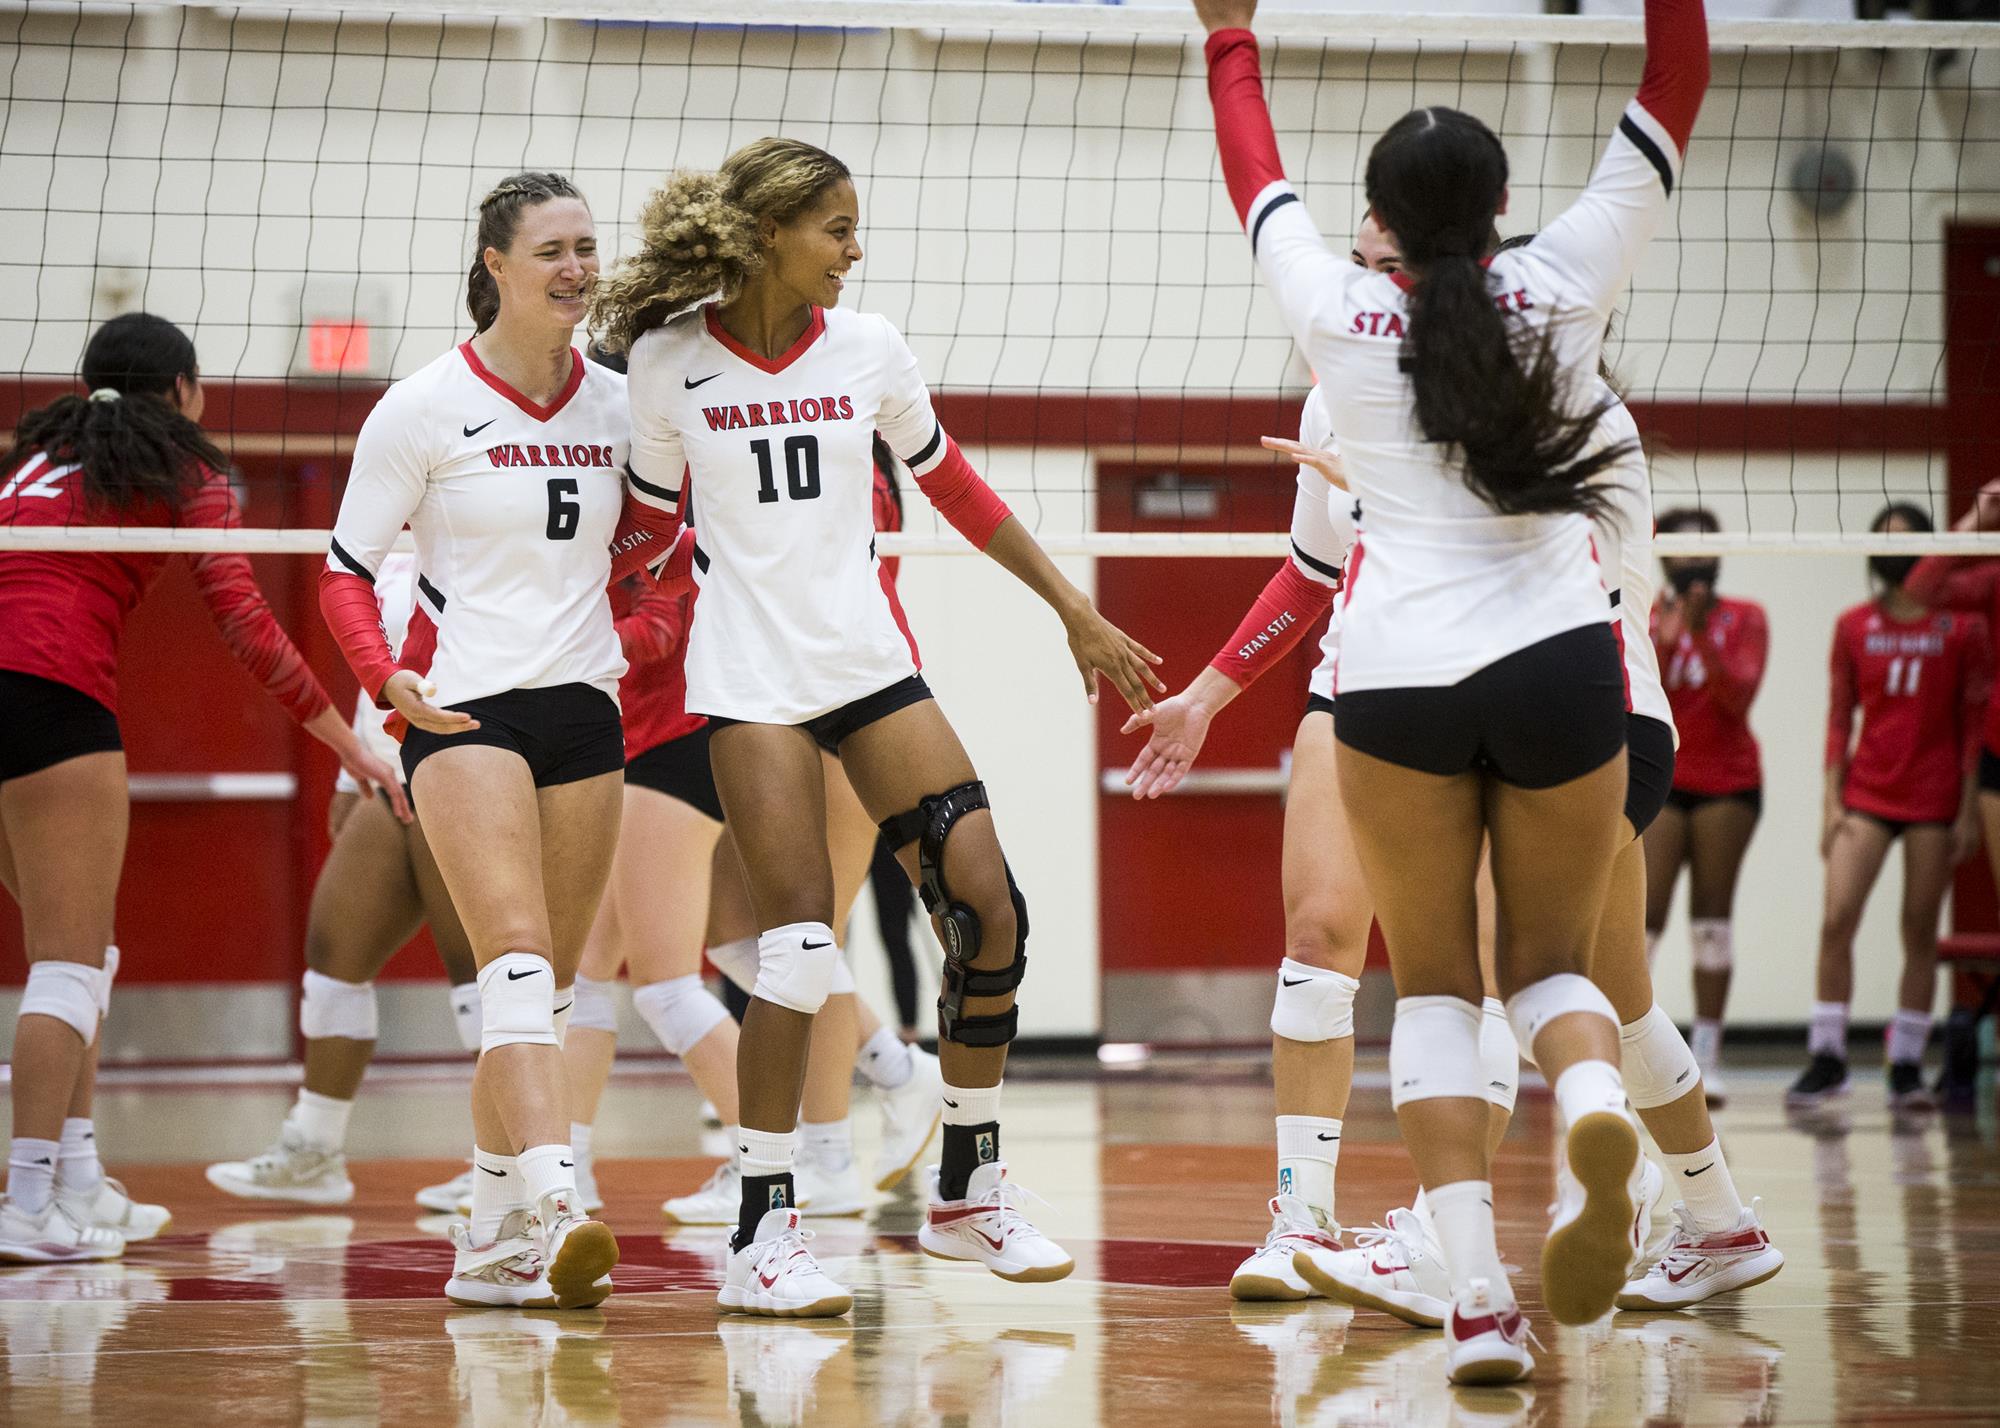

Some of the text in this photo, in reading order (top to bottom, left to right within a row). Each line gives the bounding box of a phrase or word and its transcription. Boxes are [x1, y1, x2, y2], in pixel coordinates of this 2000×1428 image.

[1349, 311, 1405, 338] STA
[702, 395, 854, 431] WARRIORS
[487, 444, 614, 468] WARRIORS
[750, 435, 821, 503] 10
[546, 478, 580, 540] 6
[1238, 632, 1271, 660] STAN
[1885, 656, 1922, 697] 11
